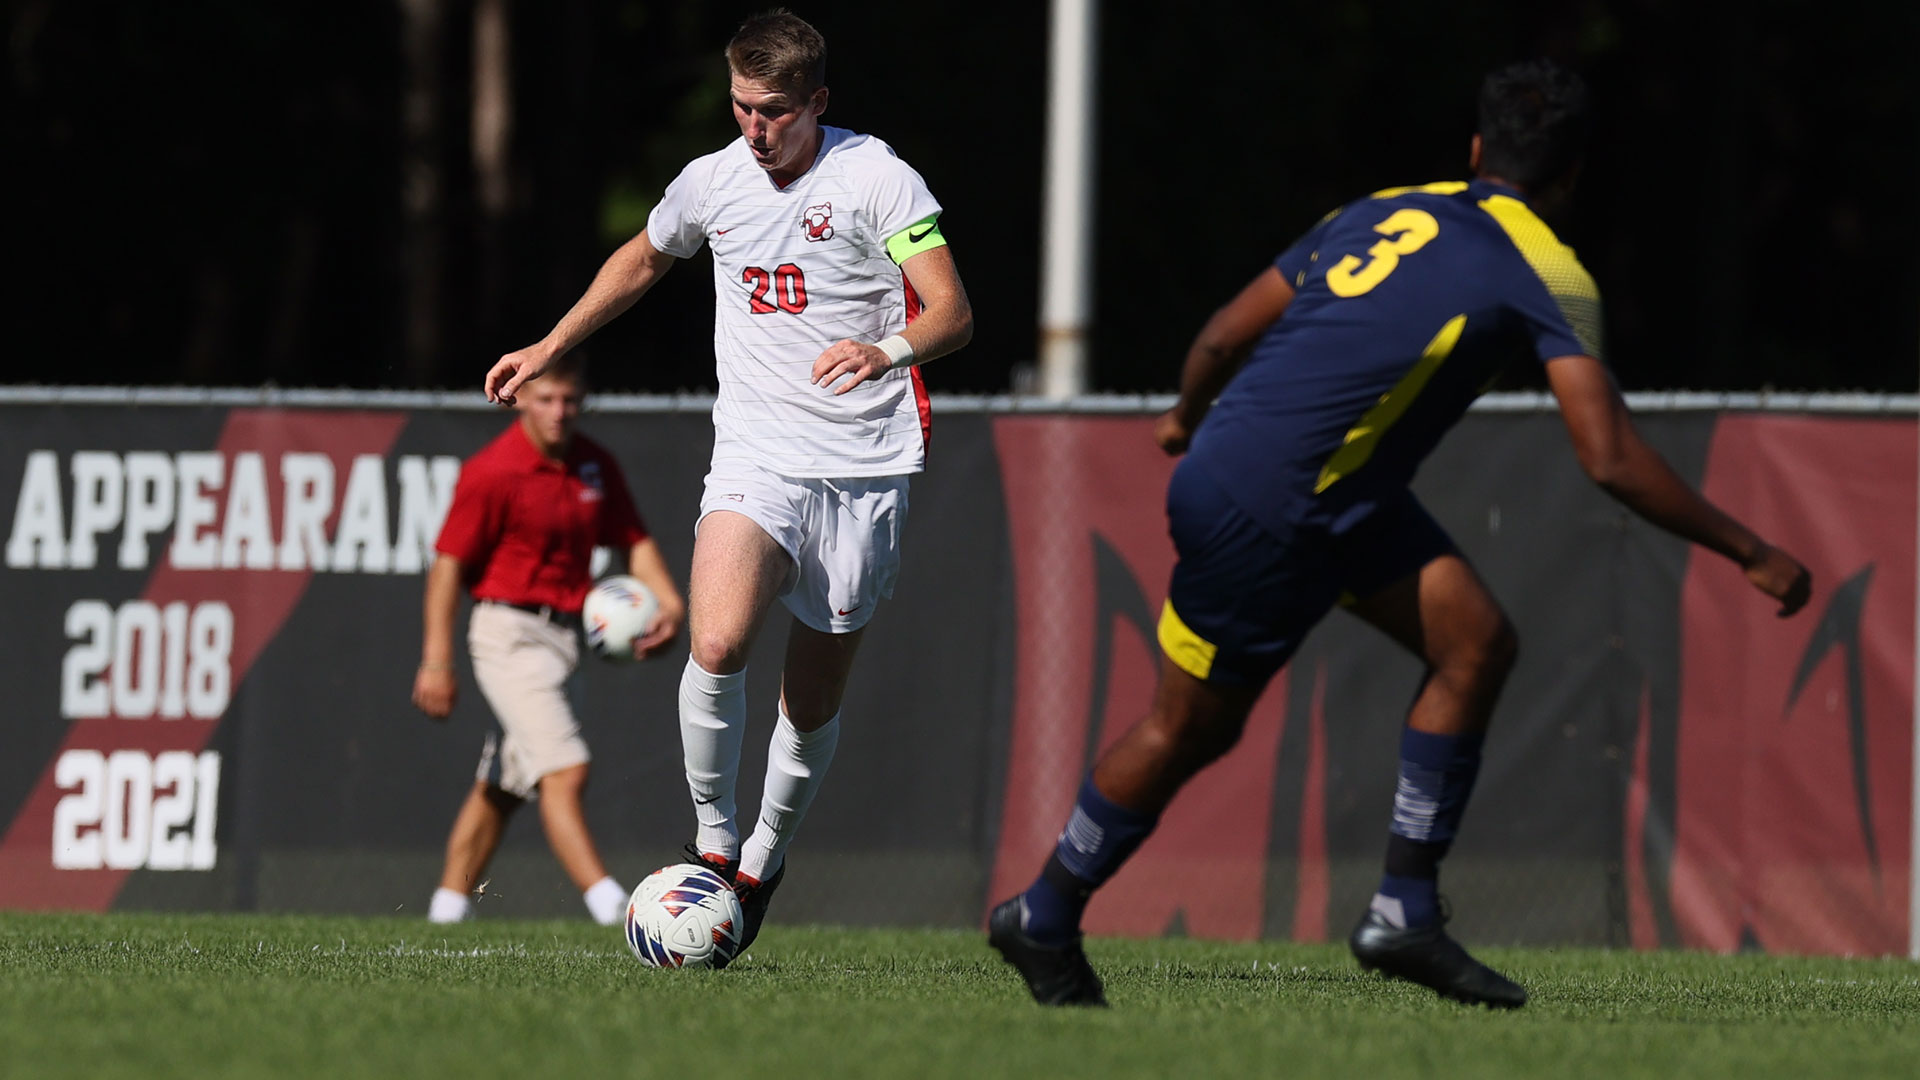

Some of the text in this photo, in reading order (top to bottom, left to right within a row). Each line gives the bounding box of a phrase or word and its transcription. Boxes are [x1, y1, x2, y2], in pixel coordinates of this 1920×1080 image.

[743, 263, 808, 315] 20
[1327, 209, 1439, 297] 3
[6, 451, 460, 573] APPEARAN
[62, 601, 232, 718] 2018
[53, 750, 219, 870] 2021
